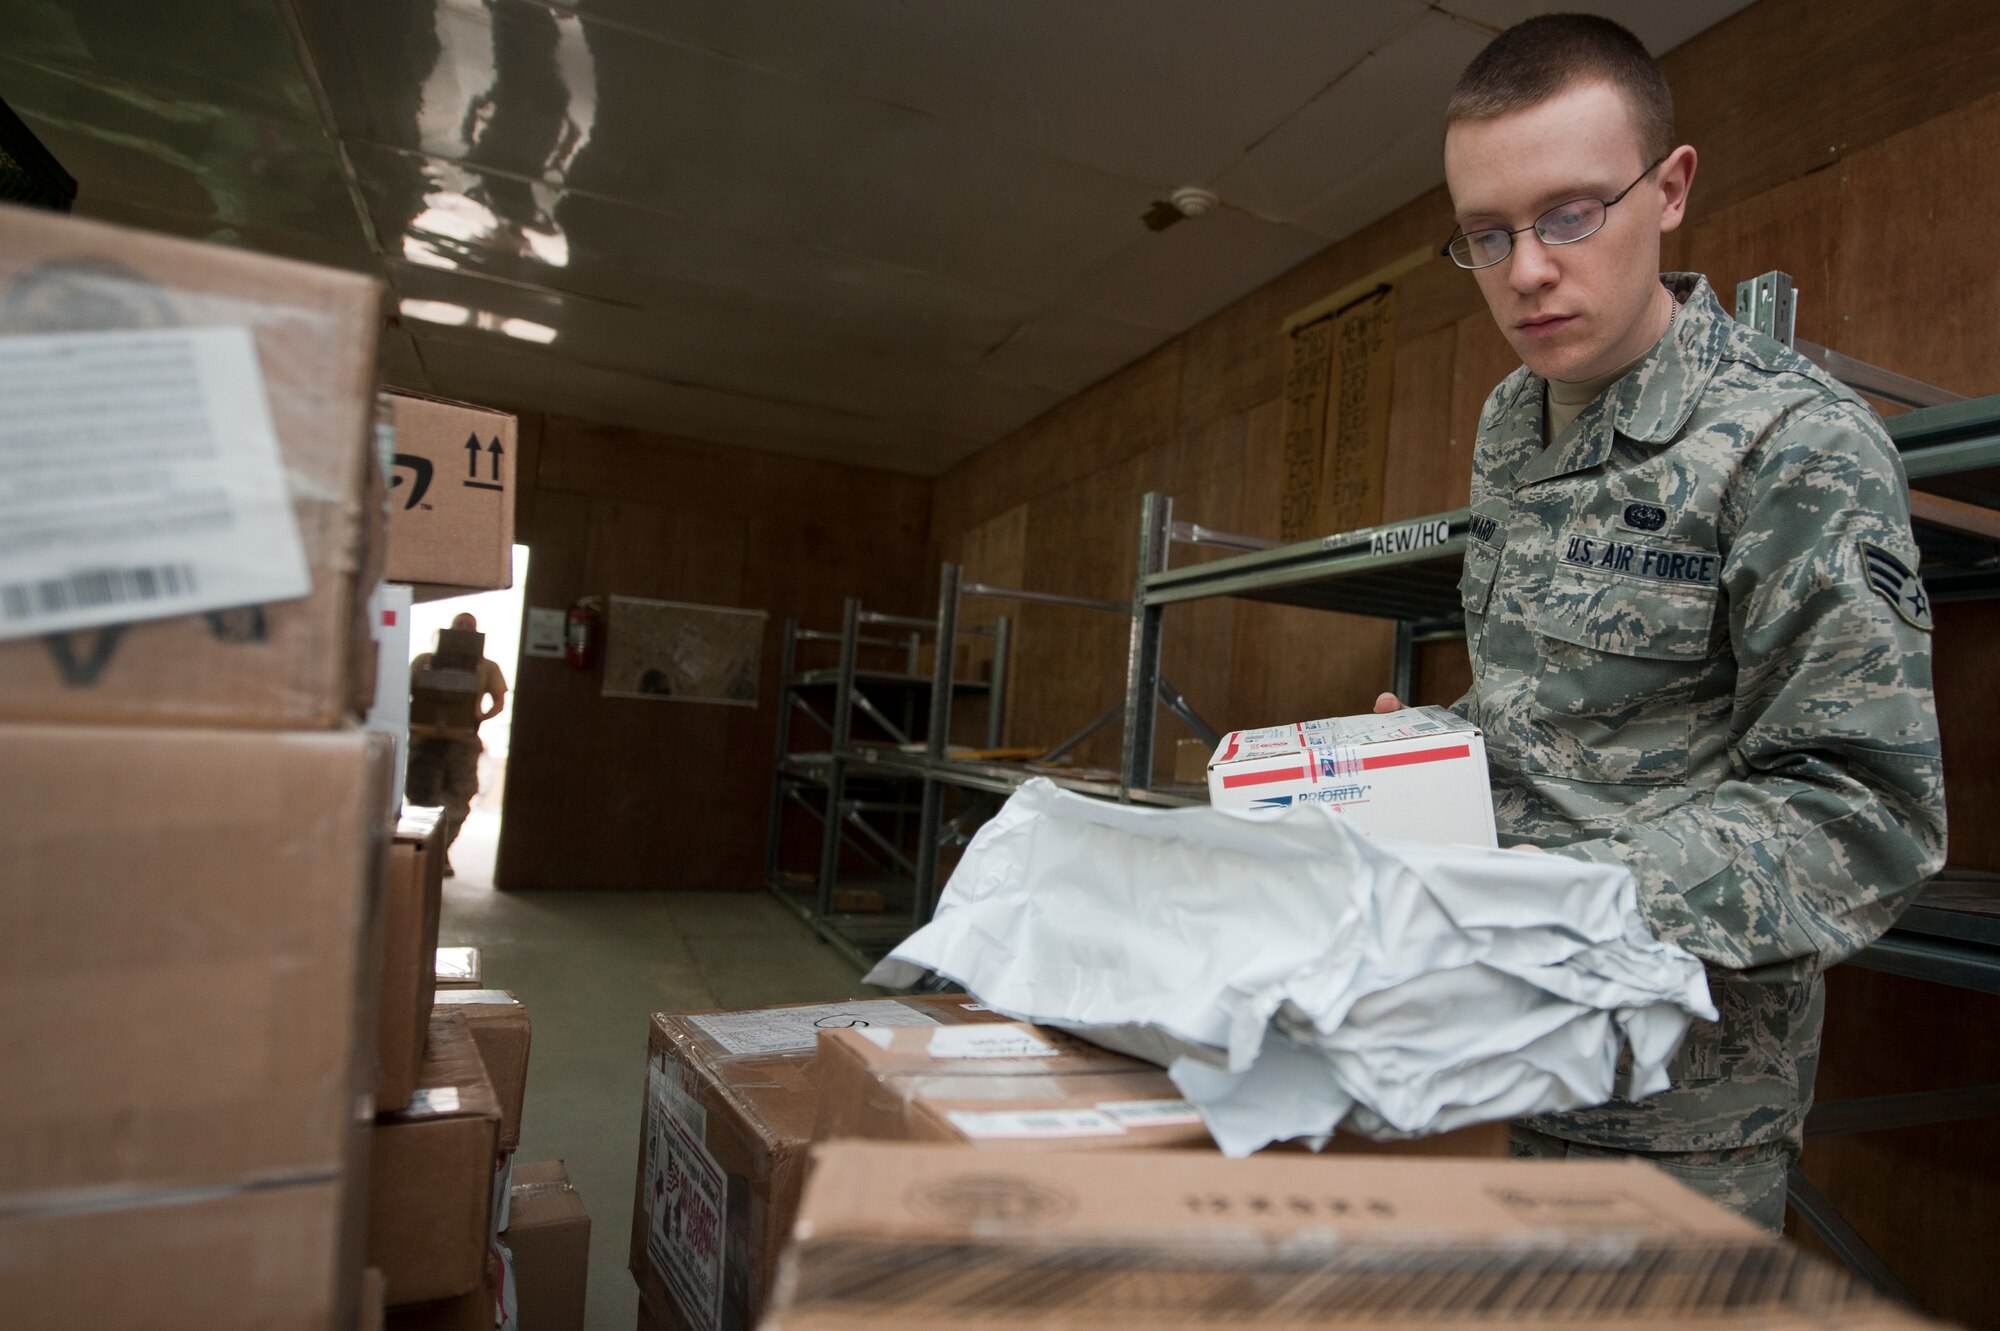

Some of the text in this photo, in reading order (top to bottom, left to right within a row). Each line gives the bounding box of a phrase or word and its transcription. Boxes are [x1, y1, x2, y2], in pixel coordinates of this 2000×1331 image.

[1373, 521, 1449, 555] AEW/HC
[1566, 537, 1714, 581] U.S. AIR FORCE
[1298, 785, 1367, 805] PRIORITY
